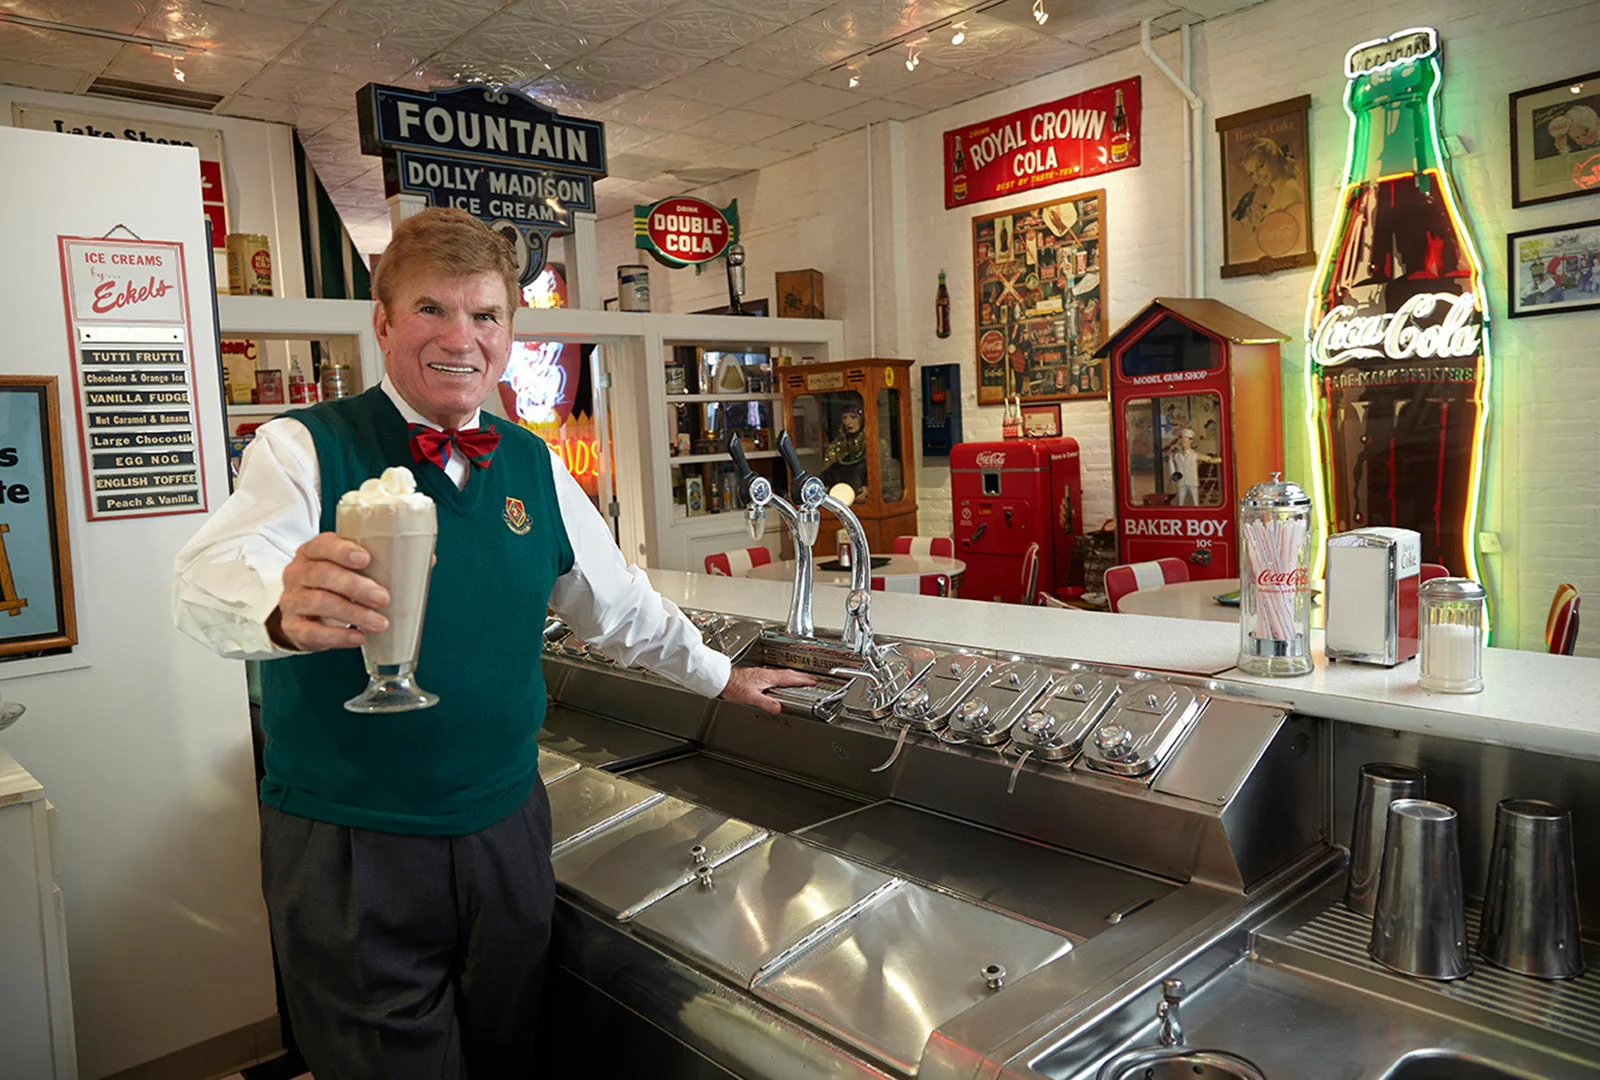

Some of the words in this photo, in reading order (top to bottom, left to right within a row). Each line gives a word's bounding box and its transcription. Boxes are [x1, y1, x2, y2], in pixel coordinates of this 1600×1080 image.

[396, 100, 588, 163] FOUNTAIN
[969, 121, 1027, 171] ROYAL
[1031, 108, 1107, 143] CROWN
[1013, 146, 1058, 177] COLA
[407, 160, 480, 191] DOLLY
[488, 170, 585, 204] MADISON
[996, 180, 1016, 192] BEST
[1018, 177, 1029, 187] BY
[1031, 166, 1079, 183] TASTE-TES
[448, 195, 481, 216] ICE
[489, 199, 555, 221] CREAM
[676, 204, 699, 214] DRINK
[653, 213, 723, 235] DOUBLE
[665, 234, 714, 254] COLA
[84, 252, 106, 264] ICE
[111, 253, 163, 267] CREAMS
[91, 275, 175, 314] Eckels
[92, 352, 131, 362] TUTTI
[135, 352, 180, 362] FRUTTI
[86, 374, 127, 383] Chocolate
[130, 374, 137, 383] &
[140, 374, 169, 383] Orange
[172, 373, 184, 382] Ice
[1132, 374, 1163, 385] MODEL
[1163, 372, 1184, 383] GUM
[1184, 370, 1208, 381] SHOP
[1327, 367, 1399, 389] ADE-MARK
[1400, 365, 1480, 383] REGISTERE
[89, 393, 143, 404] VANILLA
[149, 392, 189, 402] FUDGE
[95, 415, 110, 425] Nut
[113, 415, 147, 424] Caramel
[150, 415, 157, 423] &
[160, 414, 189, 423] Banana
[94, 436, 130, 447] Large
[115, 457, 144, 467] EGG
[151, 454, 180, 465] NOG
[96, 477, 148, 489] ENGLISH
[153, 474, 195, 485] TOFFEE
[107, 497, 142, 509] Peach
[145, 496, 155, 505] &
[158, 494, 194, 505] Vanilla
[1124, 518, 1184, 536] BAKER
[1185, 518, 1228, 537] BOY
[1257, 567, 1308, 586] Coca-Cola
